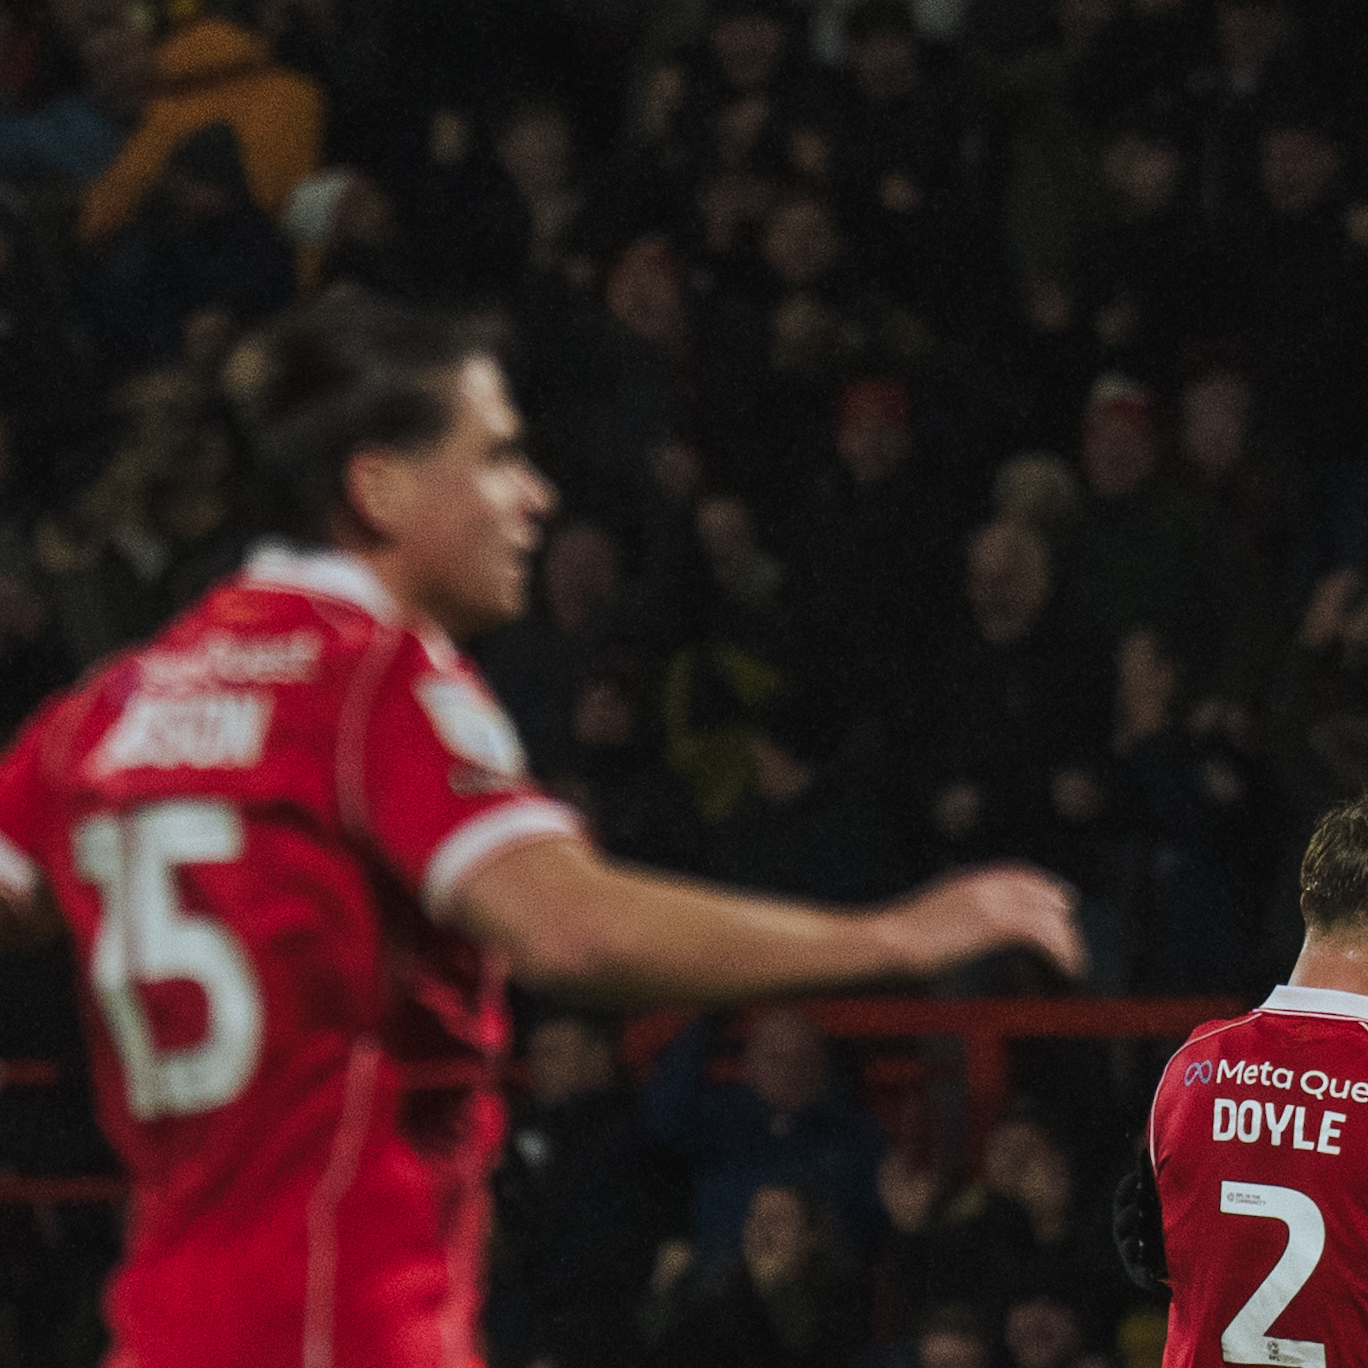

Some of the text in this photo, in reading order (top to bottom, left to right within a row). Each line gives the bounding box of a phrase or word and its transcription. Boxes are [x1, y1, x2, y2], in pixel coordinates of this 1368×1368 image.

[72, 797, 264, 1118] 15
[1216, 1058, 1292, 1090] Meta
[1212, 1097, 1347, 1156] DOYLE
